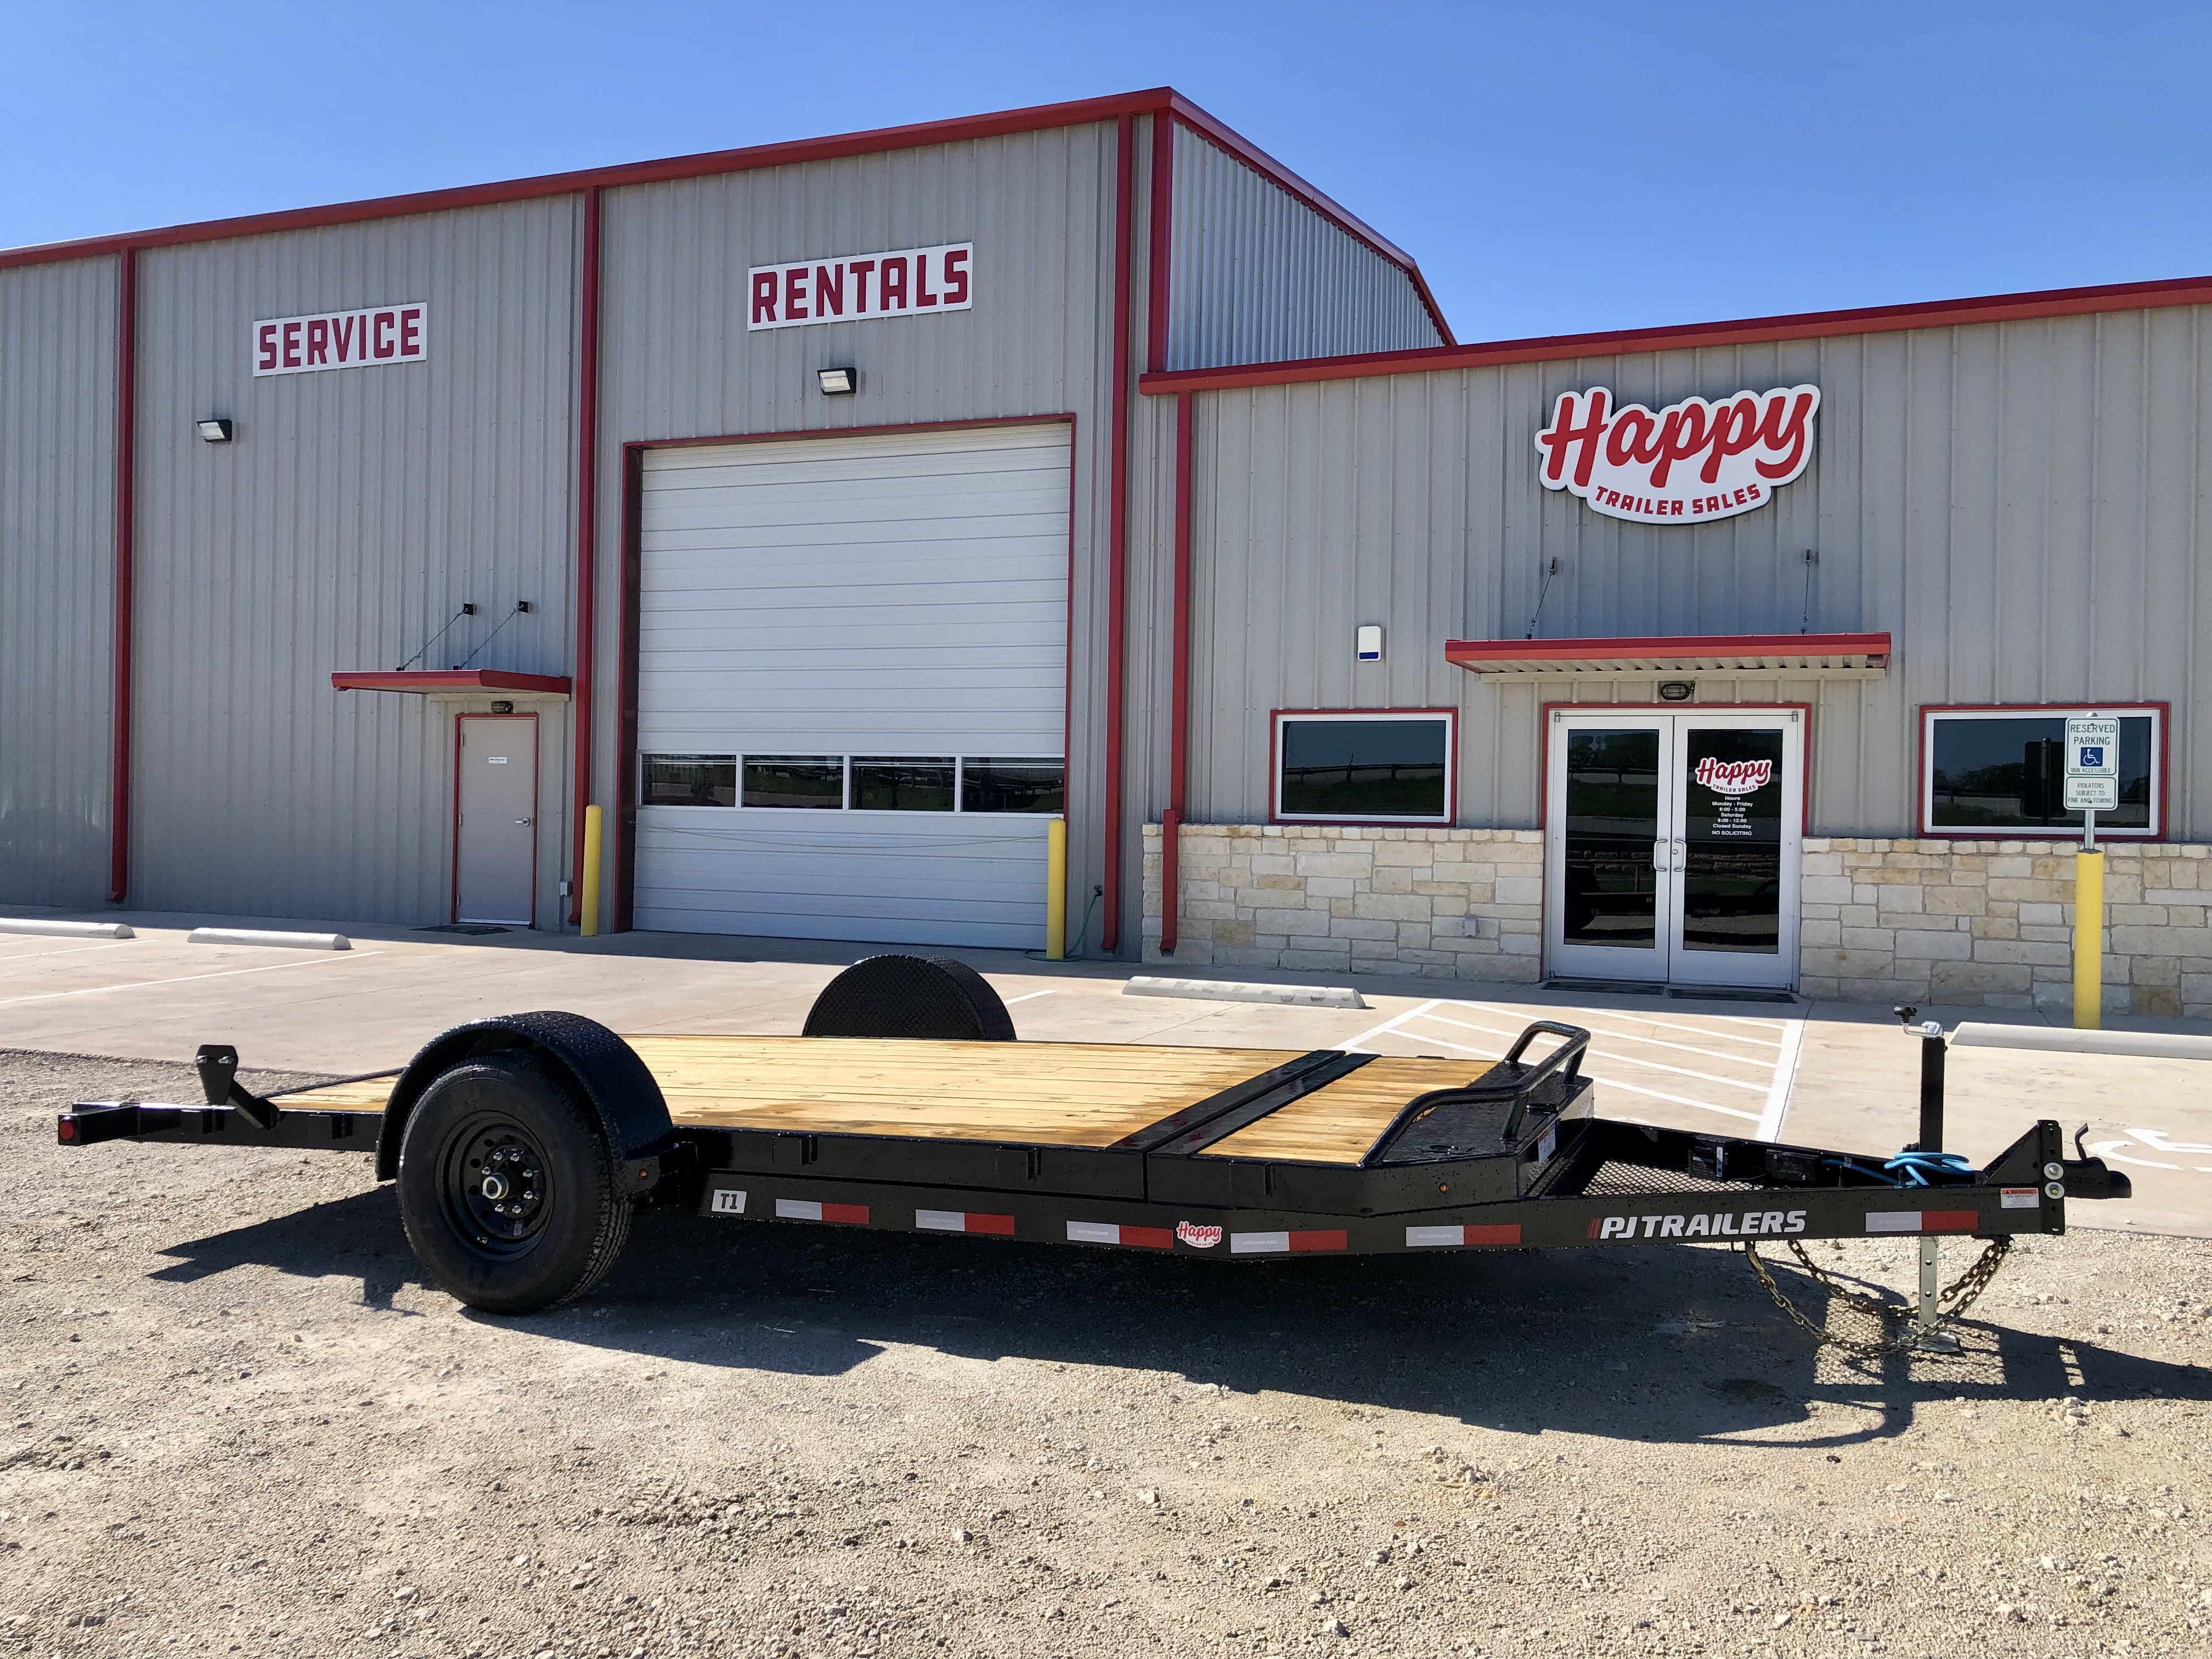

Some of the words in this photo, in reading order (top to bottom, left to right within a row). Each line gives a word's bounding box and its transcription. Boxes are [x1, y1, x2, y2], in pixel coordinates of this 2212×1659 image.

[752, 250, 968, 324] RENTALS
[259, 309, 420, 370] SERVICE
[1541, 392, 1813, 488] Happy
[1595, 486, 1683, 515] TRAILER
[1692, 483, 1760, 514] SALES
[2070, 724, 2115, 733] RESERVED
[2073, 736, 2111, 745] PARKING
[1697, 759, 1770, 785] Happy
[1713, 784, 1736, 792] TRAILER
[720, 1193, 737, 1210] T1
[1178, 1223, 1221, 1242] Happy
[1600, 1216, 1638, 1239] PJ
[1641, 1210, 1807, 1237] TRAILERS
